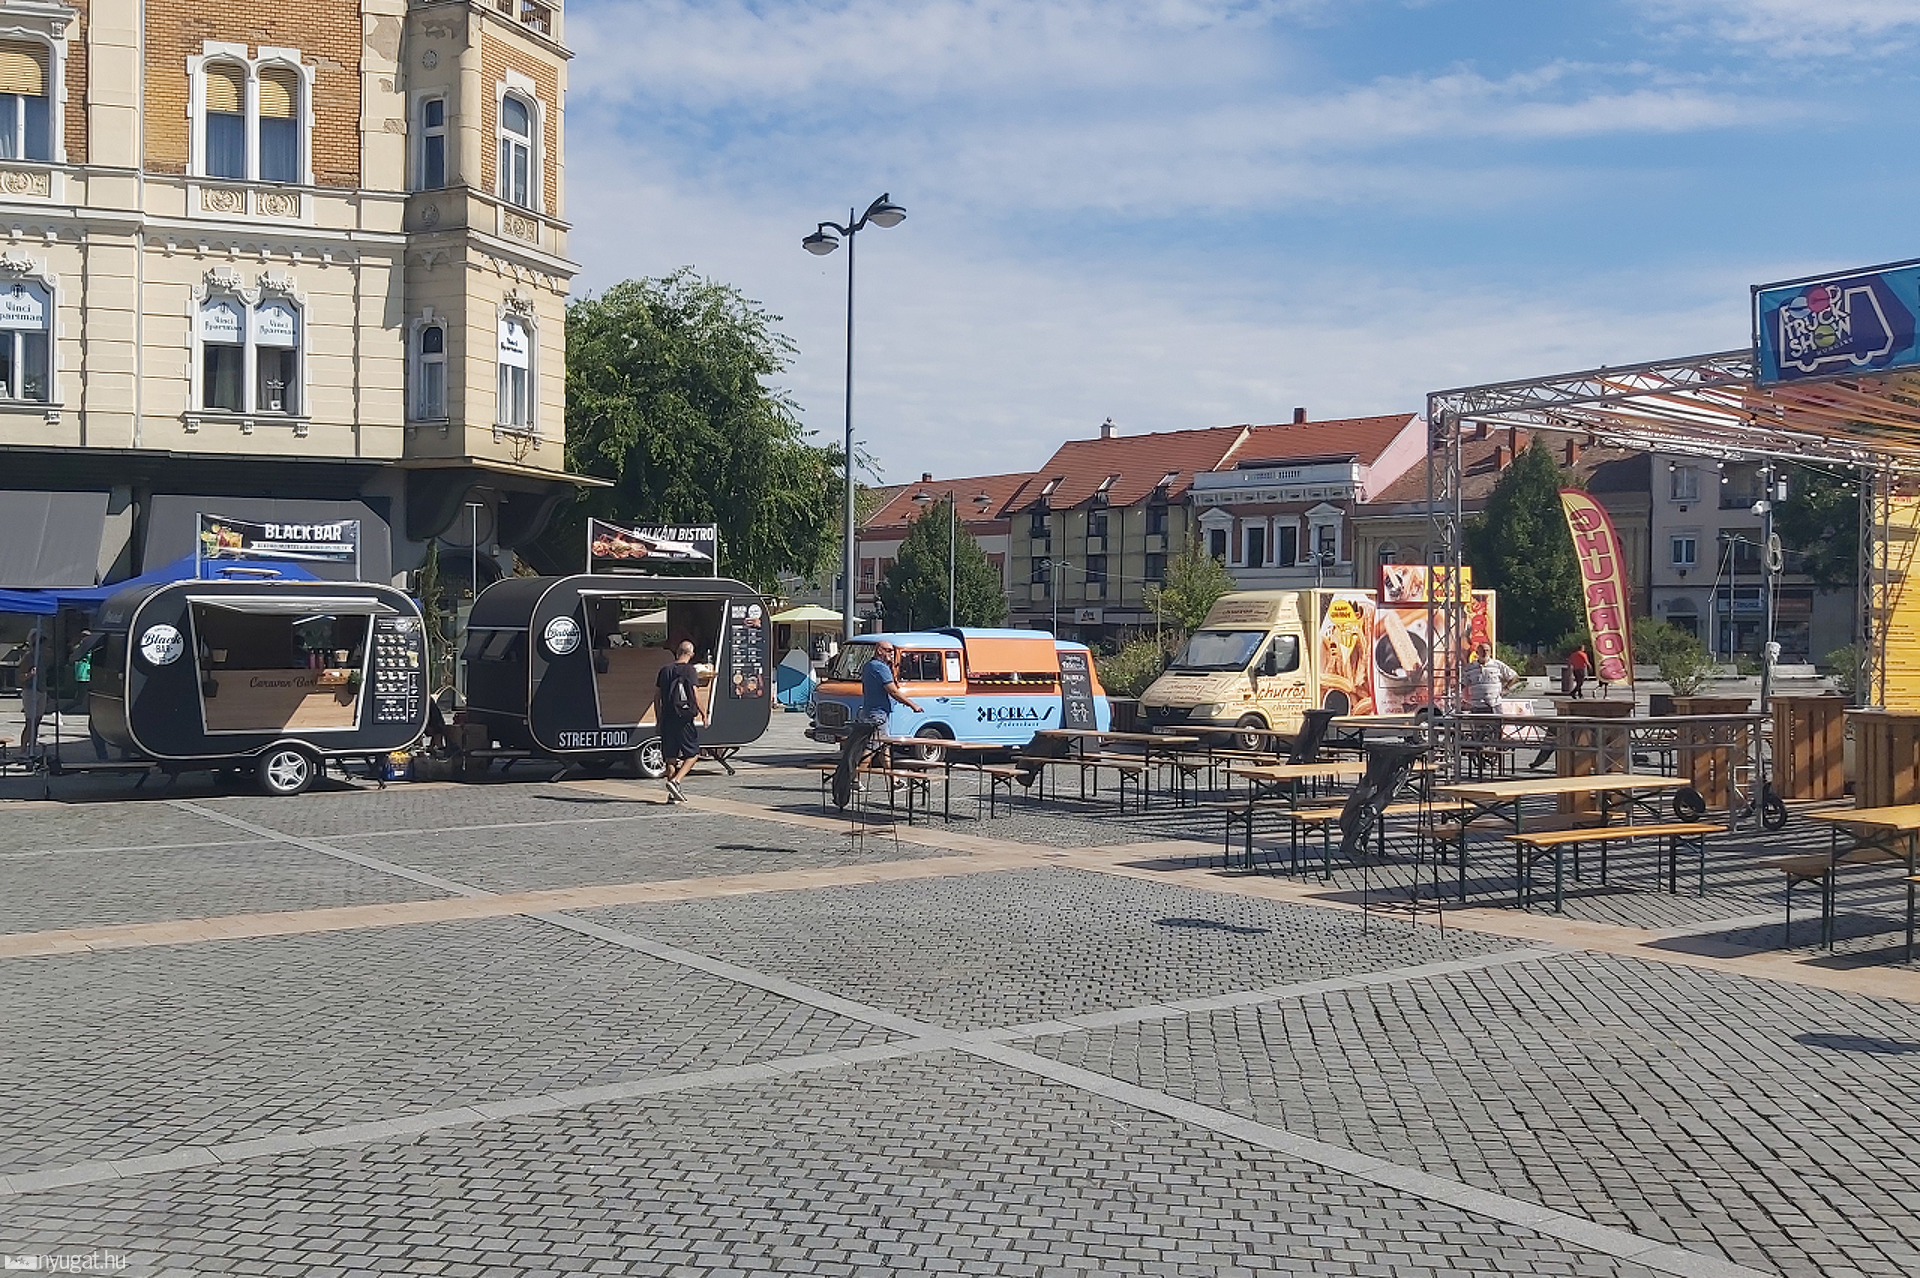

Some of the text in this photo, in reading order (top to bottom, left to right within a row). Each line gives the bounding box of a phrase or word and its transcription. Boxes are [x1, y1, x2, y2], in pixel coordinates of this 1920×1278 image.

[5, 301, 31, 312] Vinci
[1780, 284, 1842, 323] FOOD
[0, 312, 43, 322] partman
[1784, 301, 1848, 340] TRUCK
[1789, 315, 1851, 358] SHOW
[1816, 337, 1854, 356] HUNGARY
[265, 523, 342, 540] BLACK BAR
[633, 525, 713, 541] BALKÁN BISTRO
[143, 631, 182, 645] Black
[250, 676, 292, 688] Caravan
[1258, 682, 1306, 699] churros
[987, 706, 1056, 722] BORKAS
[559, 731, 628, 747] STREET FOOD
